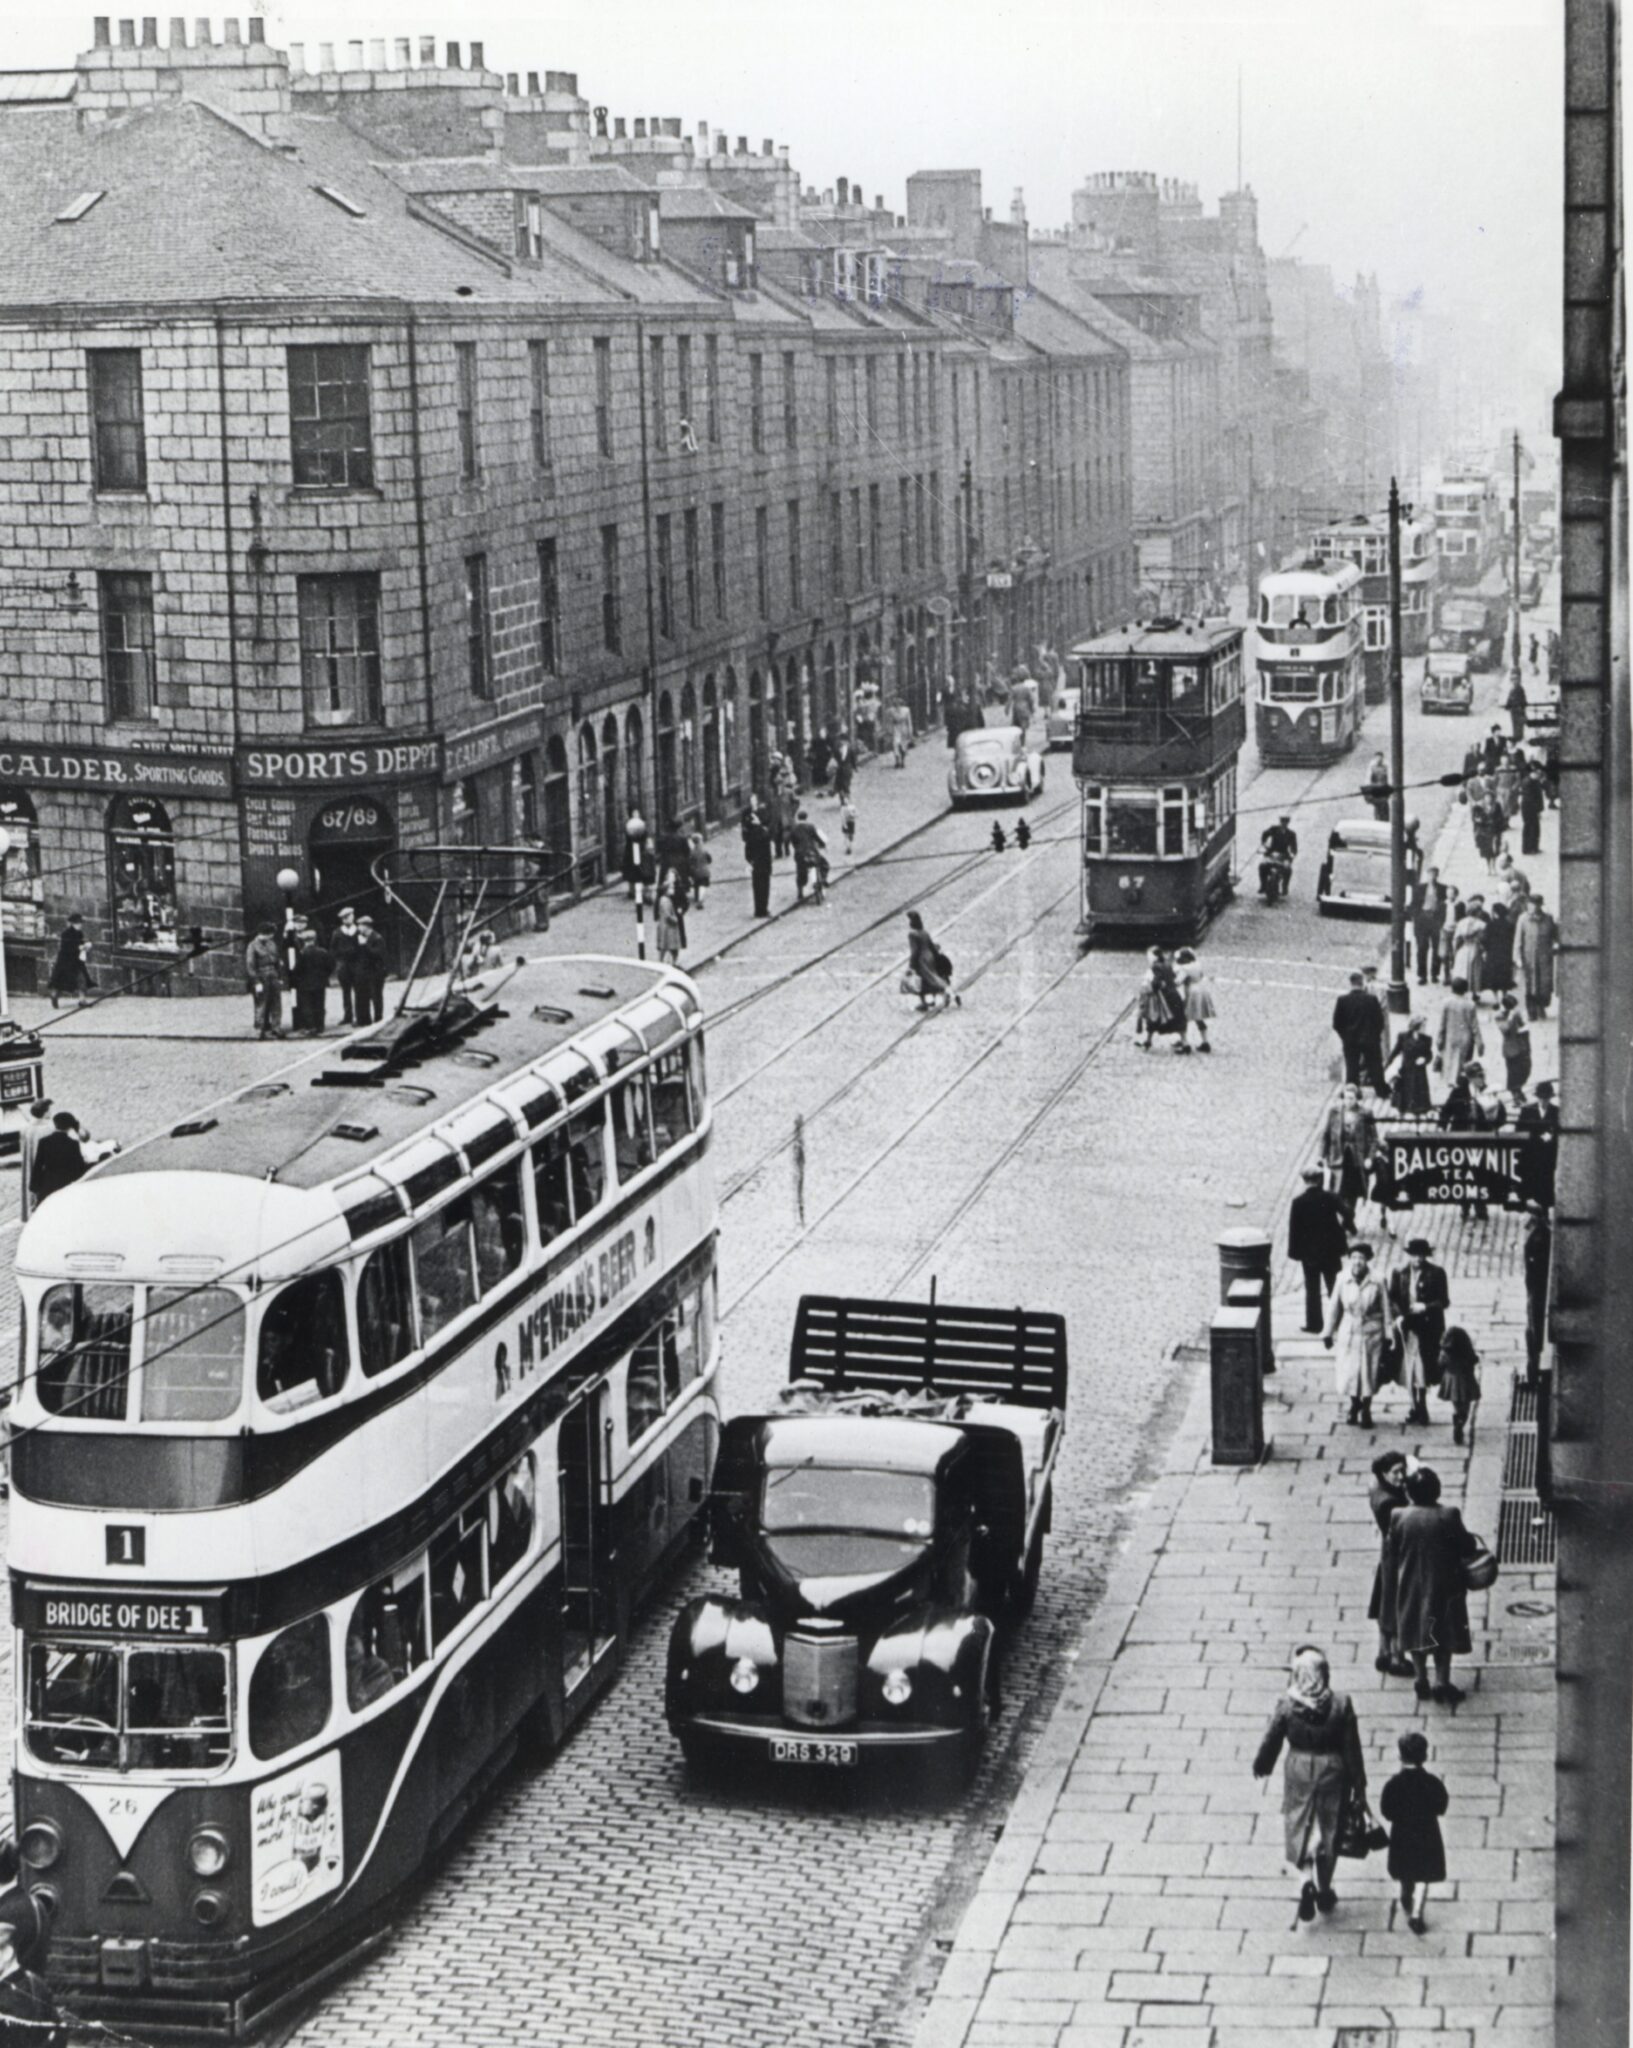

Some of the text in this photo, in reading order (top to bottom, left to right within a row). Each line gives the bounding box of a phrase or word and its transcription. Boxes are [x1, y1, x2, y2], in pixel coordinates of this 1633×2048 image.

[134, 762, 188, 785] SPORTING
[247, 752, 368, 779] SPORTS
[322, 806, 378, 832] 67/69
[1394, 1147, 1522, 1183] BALGOWNIE
[1442, 1169, 1474, 1181] TEA
[1428, 1184, 1490, 1200] ROOMS
[598, 1230, 637, 1309] BEER
[120, 1530, 134, 1560] 1
[46, 1602, 209, 1634] BRIDGE OF DEE 1
[775, 1742, 811, 1761] DRS
